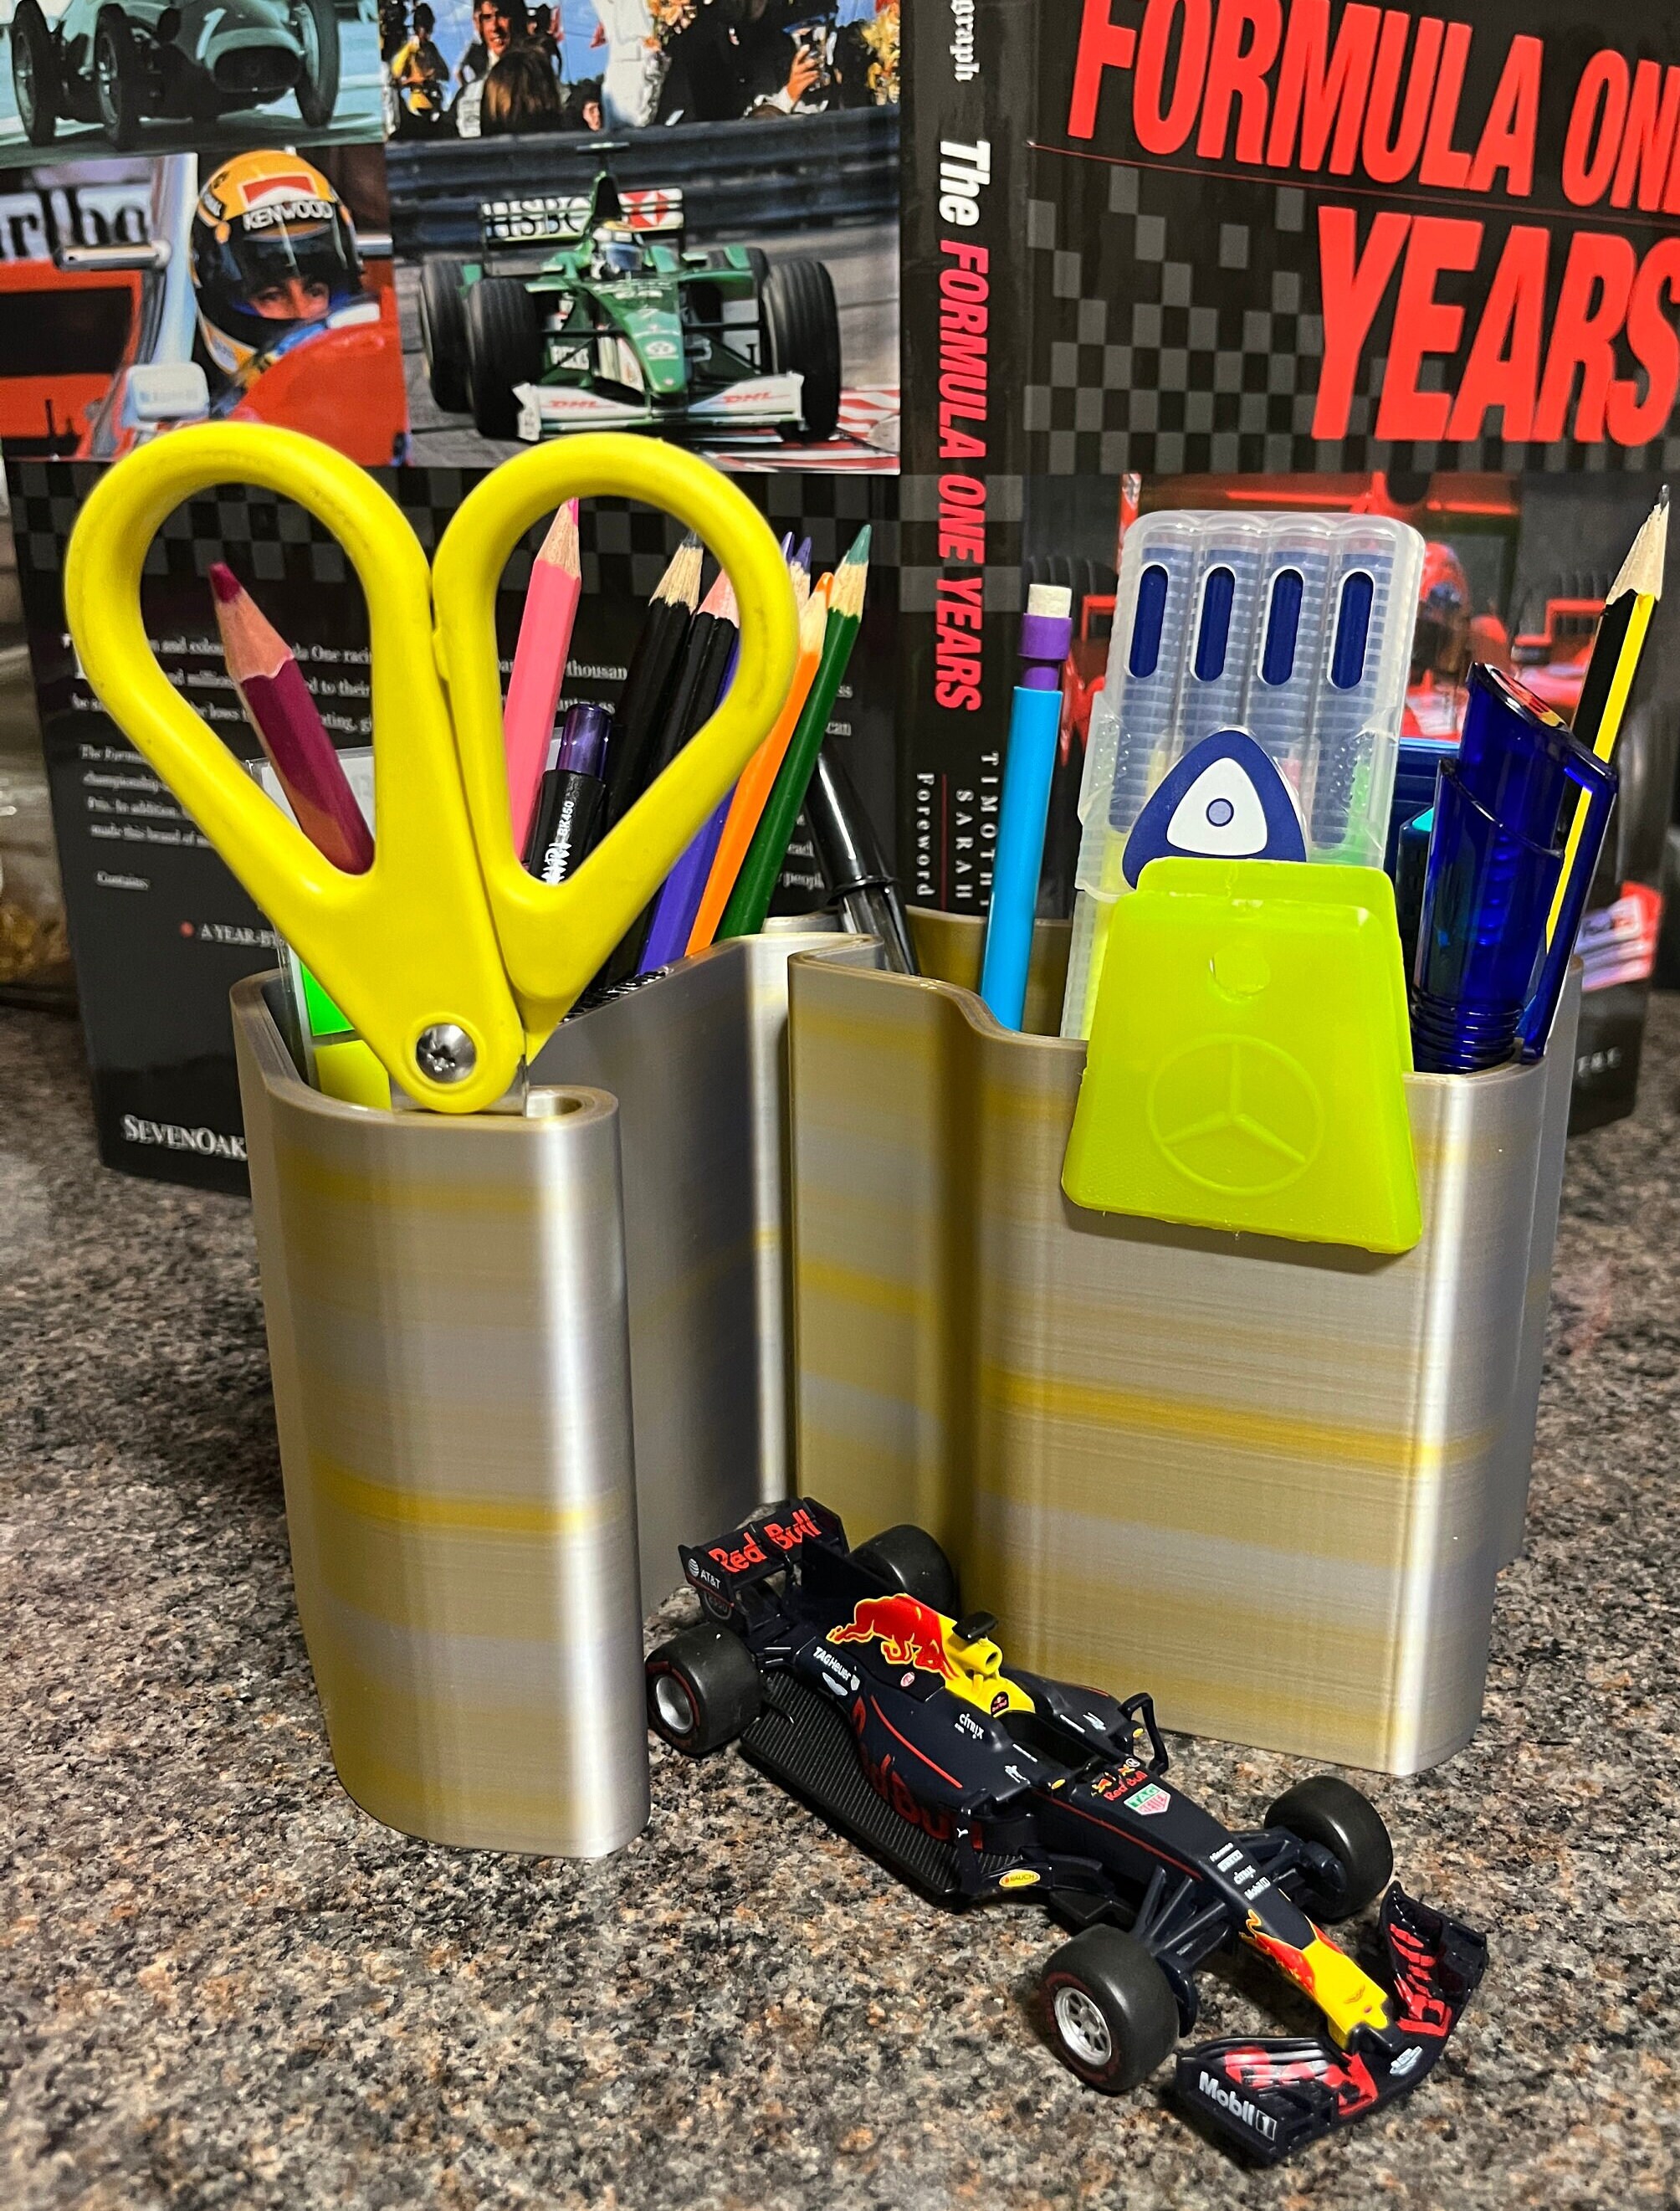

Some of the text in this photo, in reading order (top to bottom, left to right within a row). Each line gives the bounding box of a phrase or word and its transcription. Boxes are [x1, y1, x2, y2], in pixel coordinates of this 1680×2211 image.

[1068, 0, 1680, 217] FORMULA ON
[243, 200, 334, 231] KENWOOD
[1310, 205, 1680, 447] YEARS
[935, 140, 991, 711] The FORMULA ONE YEARS
[565, 659, 627, 680] thousan
[915, 772, 936, 896] Foreword
[955, 787, 975, 899] SARAH
[123, 1113, 248, 1162] SEVENOAK
[708, 1508, 822, 1573] Red Bull
[700, 1569, 722, 1590] AT&T
[1104, 1770, 1149, 1801] Red Bull
[1129, 1784, 1161, 1808] TAG
[1198, 2070, 1256, 2126] Mobil
